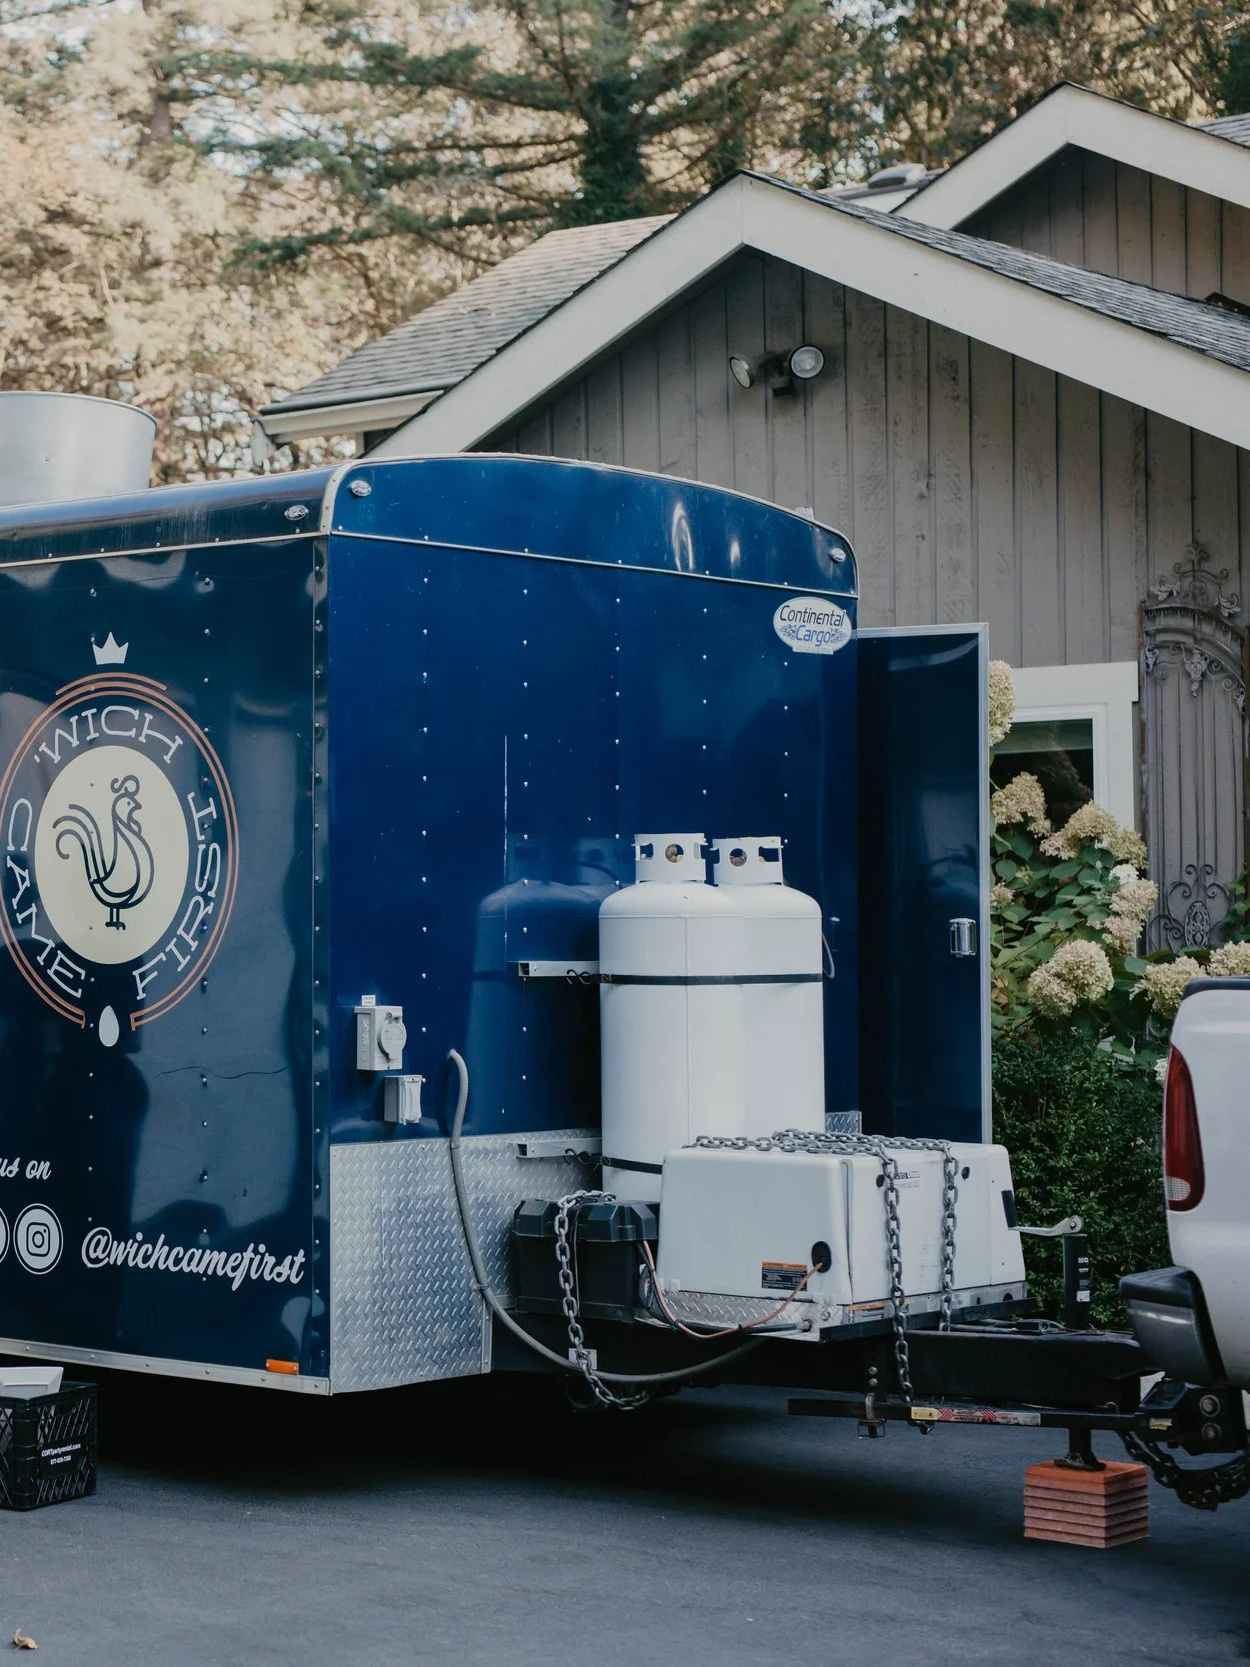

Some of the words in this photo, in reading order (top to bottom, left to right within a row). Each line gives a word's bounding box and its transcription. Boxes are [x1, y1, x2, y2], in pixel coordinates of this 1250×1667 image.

[780, 605, 845, 627] Continental
[795, 624, 831, 647] Cargo
[6, 797, 86, 998] CAME
[132, 791, 221, 1000] FIRST
[25, 1158, 52, 1181] on
[81, 1227, 306, 1291] @wichcamefirst
